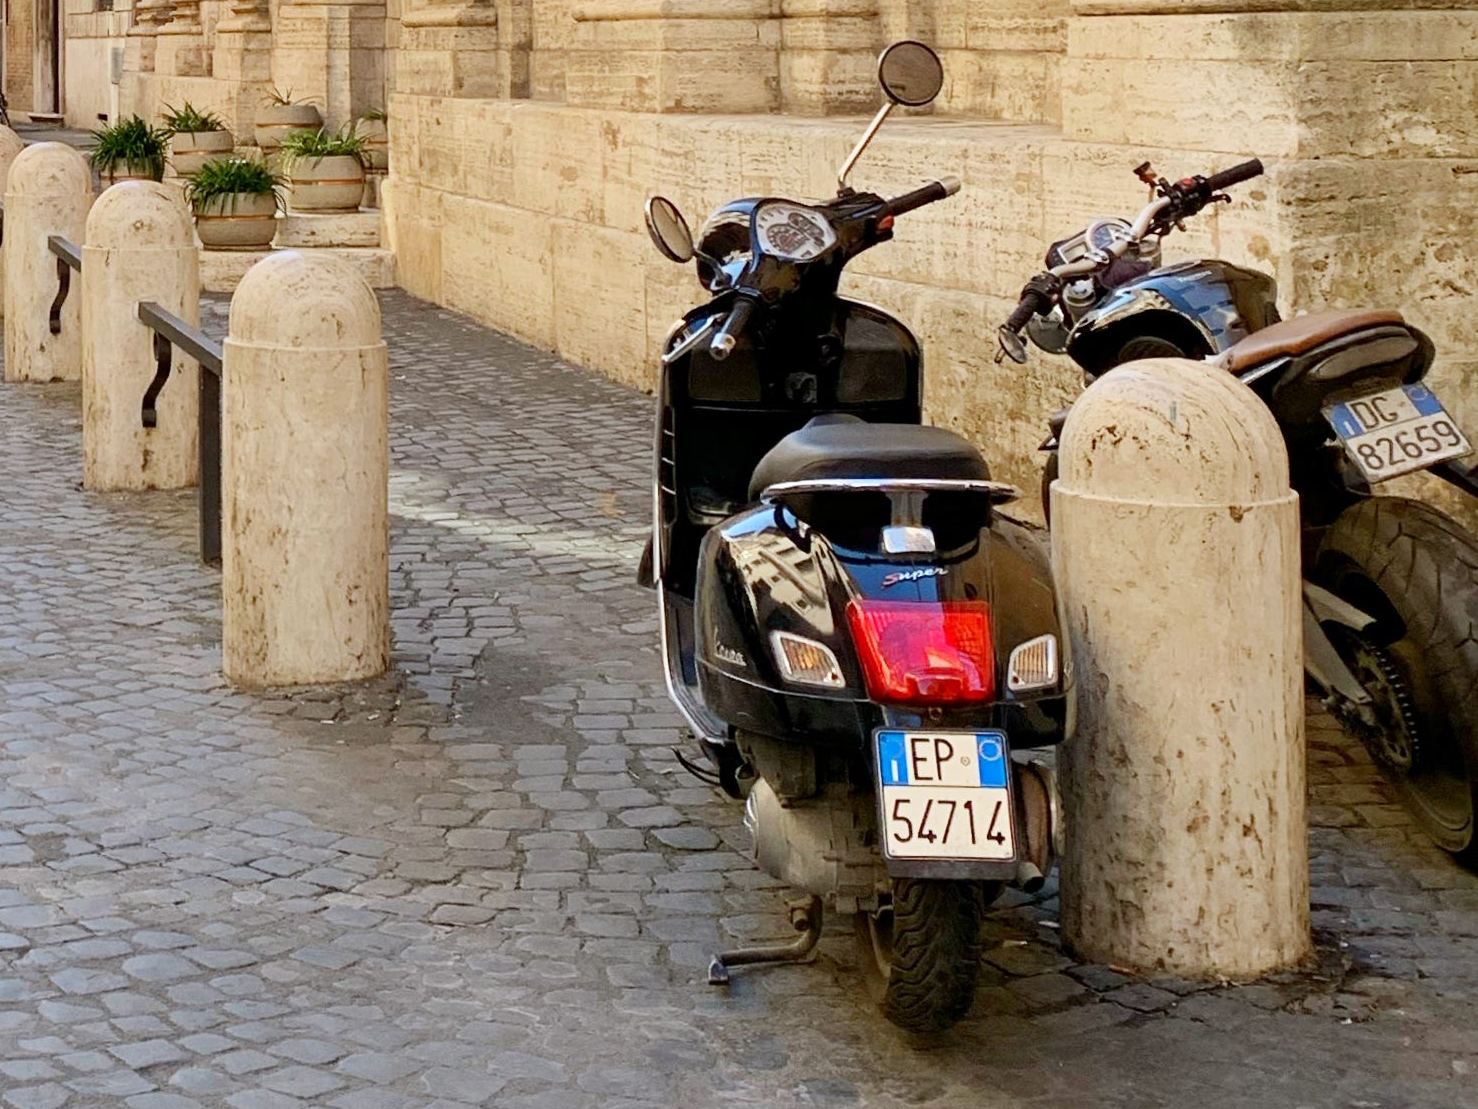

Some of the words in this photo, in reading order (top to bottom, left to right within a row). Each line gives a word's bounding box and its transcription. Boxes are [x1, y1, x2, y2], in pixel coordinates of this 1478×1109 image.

[1351, 396, 1398, 429] DG
[1357, 420, 1461, 471] 82659
[882, 567, 949, 587] Super
[910, 738, 954, 781] EP
[892, 798, 1006, 845] 54714
